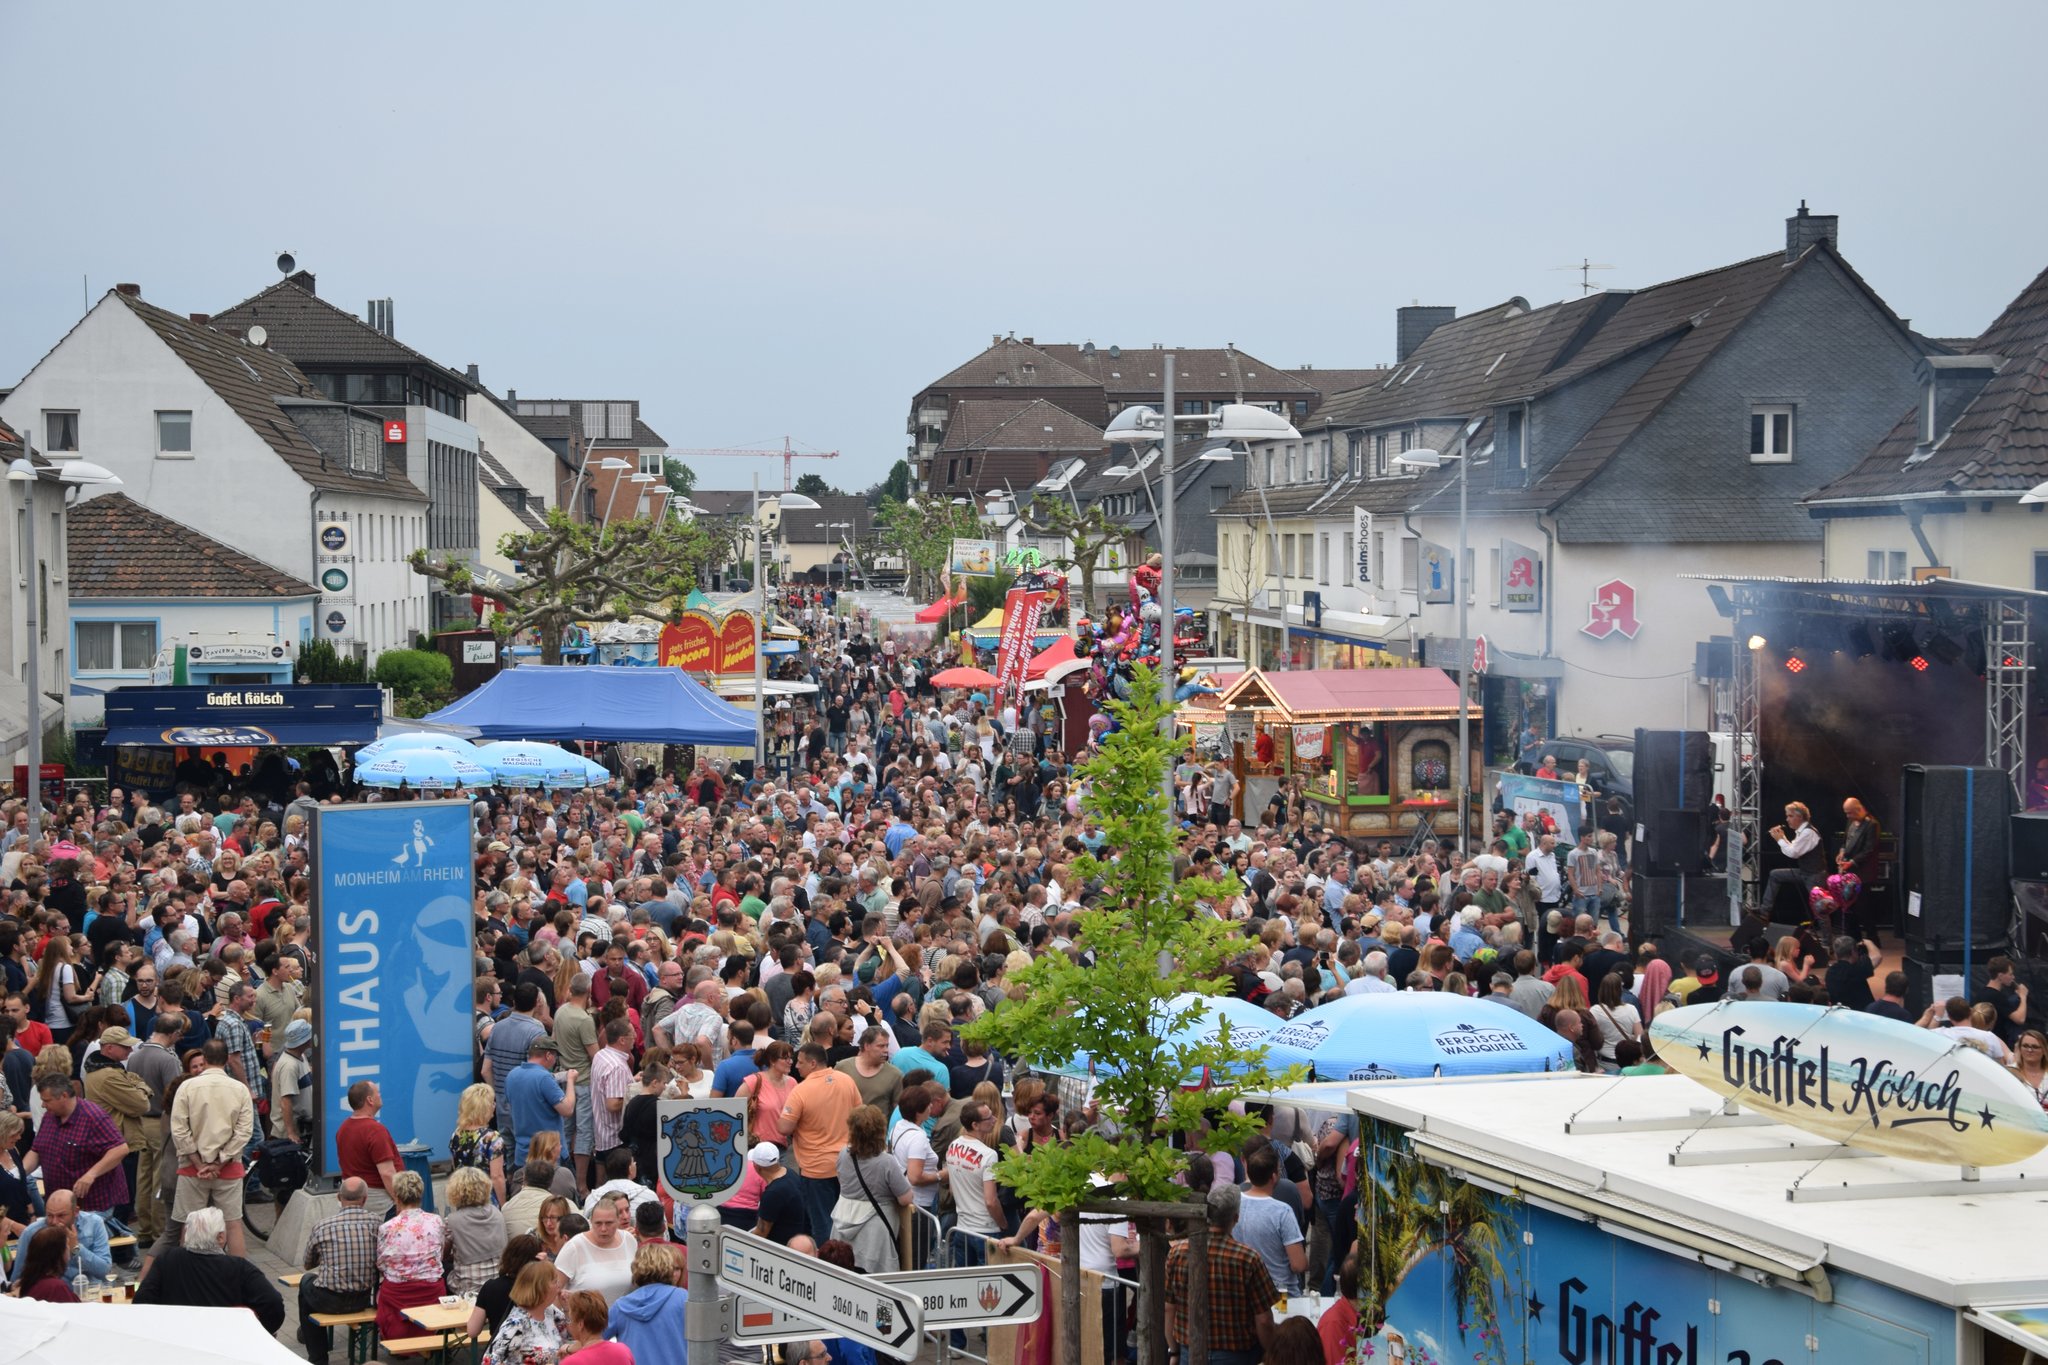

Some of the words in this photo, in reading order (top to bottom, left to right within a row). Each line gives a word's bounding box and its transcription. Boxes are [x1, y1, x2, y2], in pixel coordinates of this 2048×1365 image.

[1357, 514, 1371, 582] palmshoes
[1001, 600, 1024, 650] BRATWURST
[1020, 605, 1035, 658] BRATWURST
[669, 643, 683, 655] stets
[684, 635, 707, 649] frisches
[1017, 646, 1032, 706] CURRYWURST
[1031, 599, 1042, 637] POMMES
[667, 646, 710, 667] Popcorn
[207, 692, 242, 706] Gaffel
[245, 692, 284, 706] Kölsch
[334, 872, 400, 887] MONHEIM
[402, 869, 421, 882] AM
[424, 867, 464, 882] RHEIN
[338, 909, 380, 1123] THAUS
[1203, 1029, 1271, 1043] BEGISCH
[1268, 1034, 1319, 1051] WALDQUELLE
[1276, 1027, 1329, 1042] BERGISCHE
[1435, 1032, 1520, 1047] BERGISCHE
[1442, 1042, 1528, 1055] WALDQUELLE
[1349, 1073, 1398, 1081] BERGISCHE
[1722, 1025, 1834, 1112] Gaffel
[1842, 1057, 1970, 1132] Kölsch
[750, 1256, 774, 1286] Tirat
[778, 1268, 817, 1303] Carmel
[832, 1295, 853, 1317] 3060
[855, 1300, 869, 1324] km
[950, 1294, 968, 1310] km
